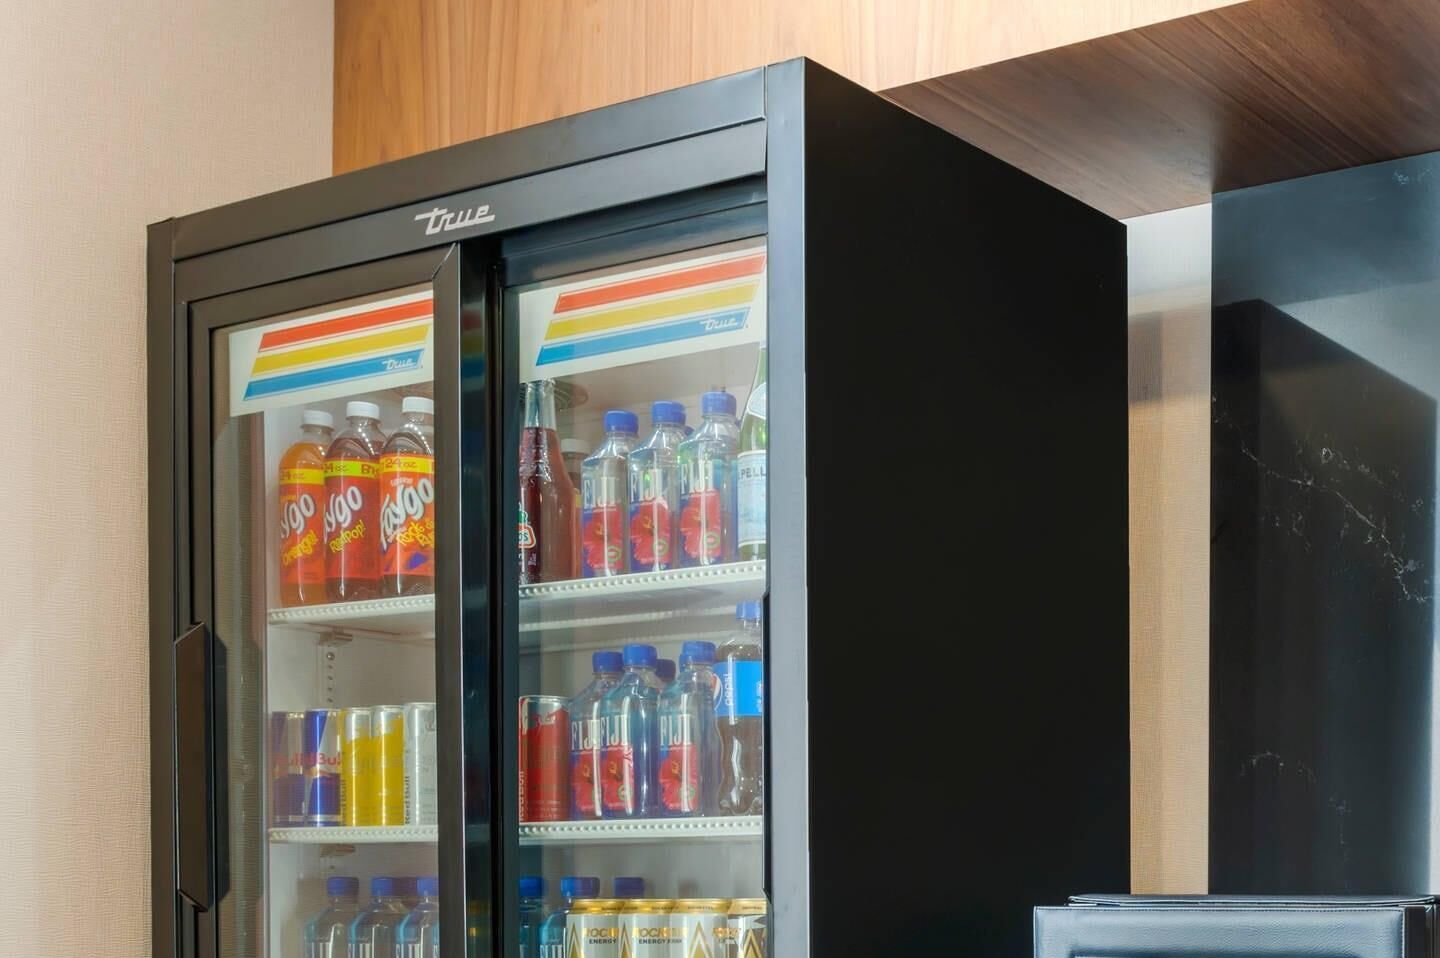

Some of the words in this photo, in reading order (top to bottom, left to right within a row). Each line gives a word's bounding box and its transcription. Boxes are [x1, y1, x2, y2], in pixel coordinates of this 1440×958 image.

[280, 493, 315, 538] ygo
[600, 713, 630, 746] FIJI
[660, 714, 692, 746] FIJI
